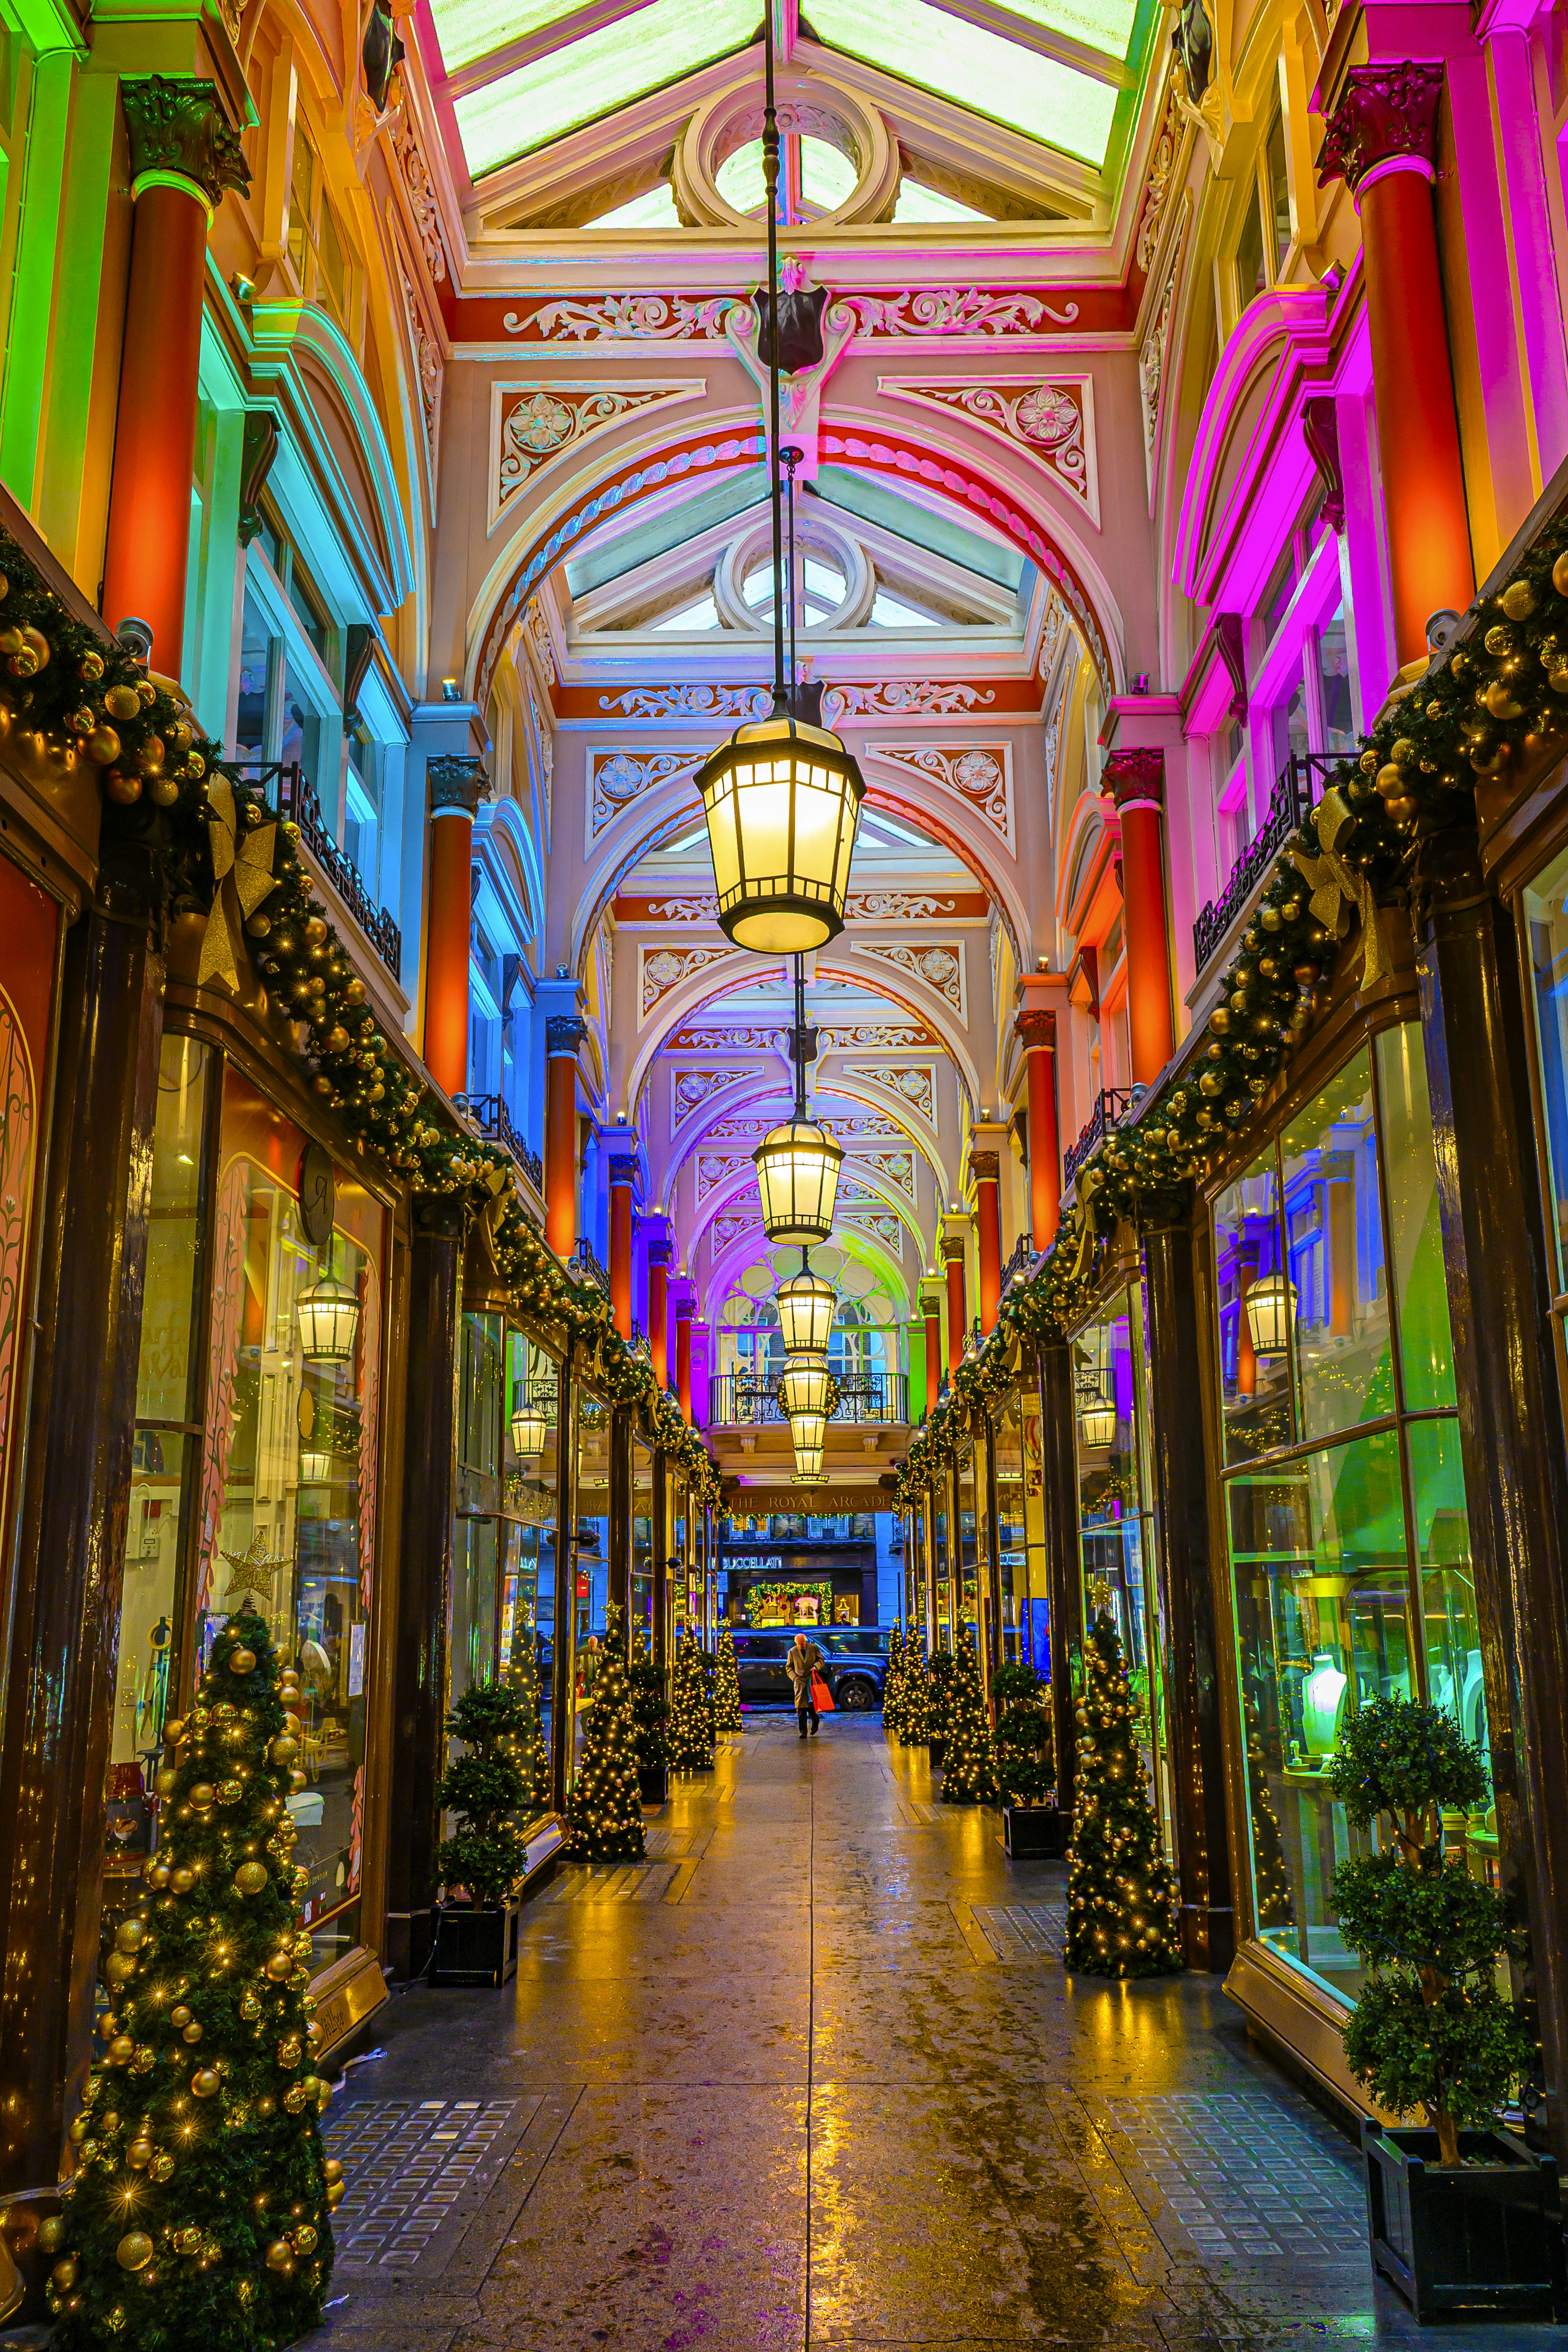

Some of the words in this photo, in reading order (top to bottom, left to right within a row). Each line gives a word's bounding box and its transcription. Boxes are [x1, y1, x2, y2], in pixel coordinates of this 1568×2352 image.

[728, 1497, 759, 1509] THE
[769, 1496, 818, 1509] ROYAL
[828, 1495, 891, 1508] ARCADE
